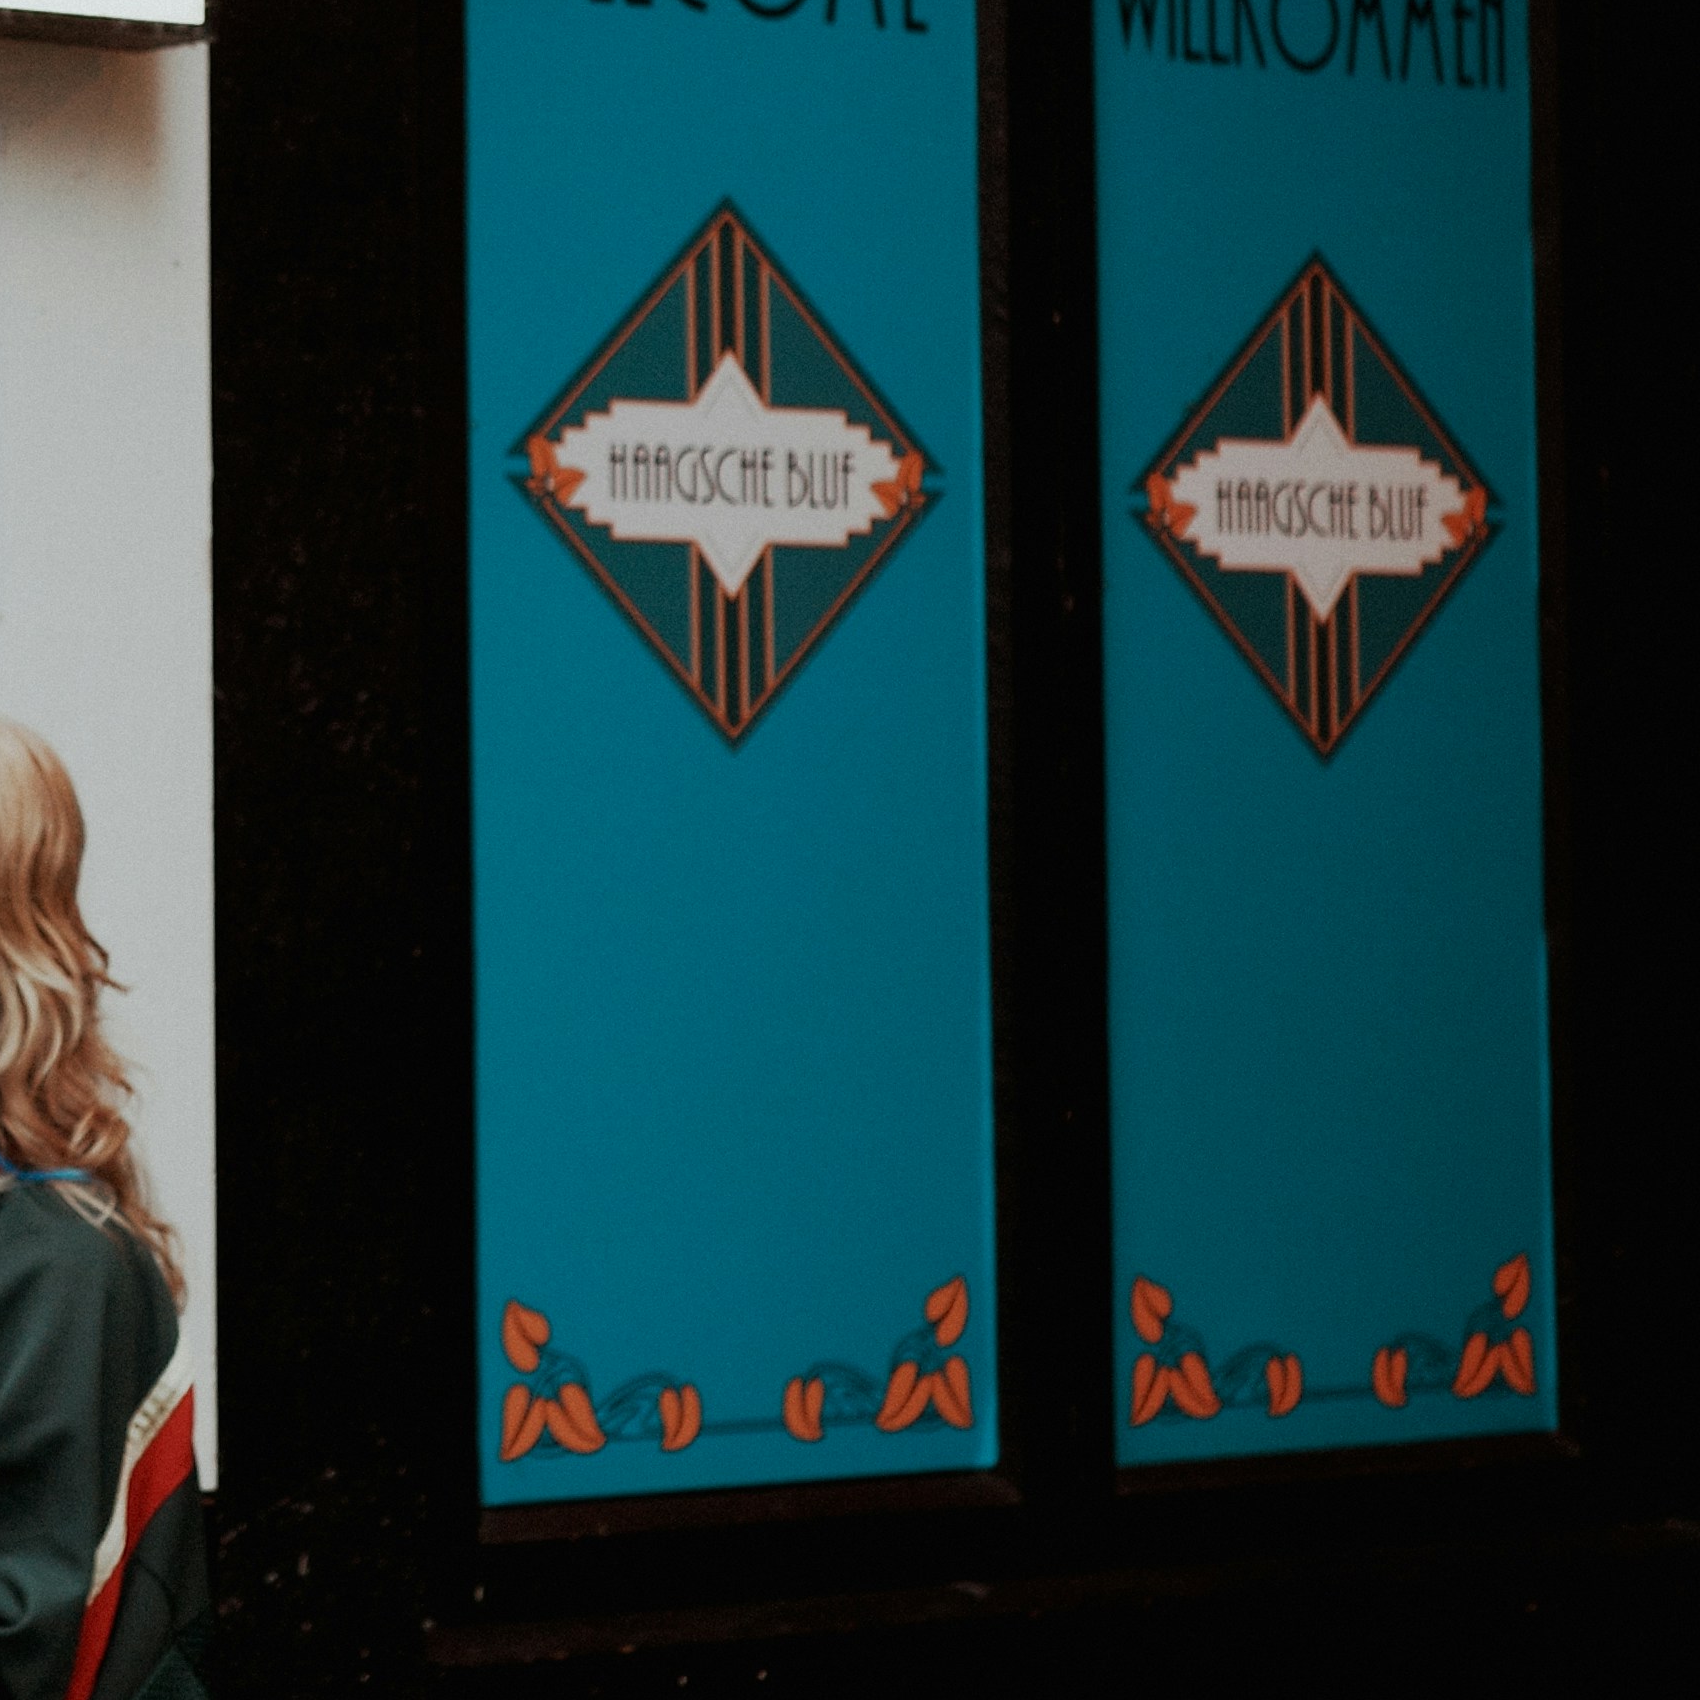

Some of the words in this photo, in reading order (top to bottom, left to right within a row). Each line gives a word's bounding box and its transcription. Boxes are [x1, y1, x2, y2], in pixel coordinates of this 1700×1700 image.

[608, 443, 774, 508] HAAGSCHE
[786, 450, 855, 510] BLUF
[1215, 477, 1359, 540] HAAGSCHE
